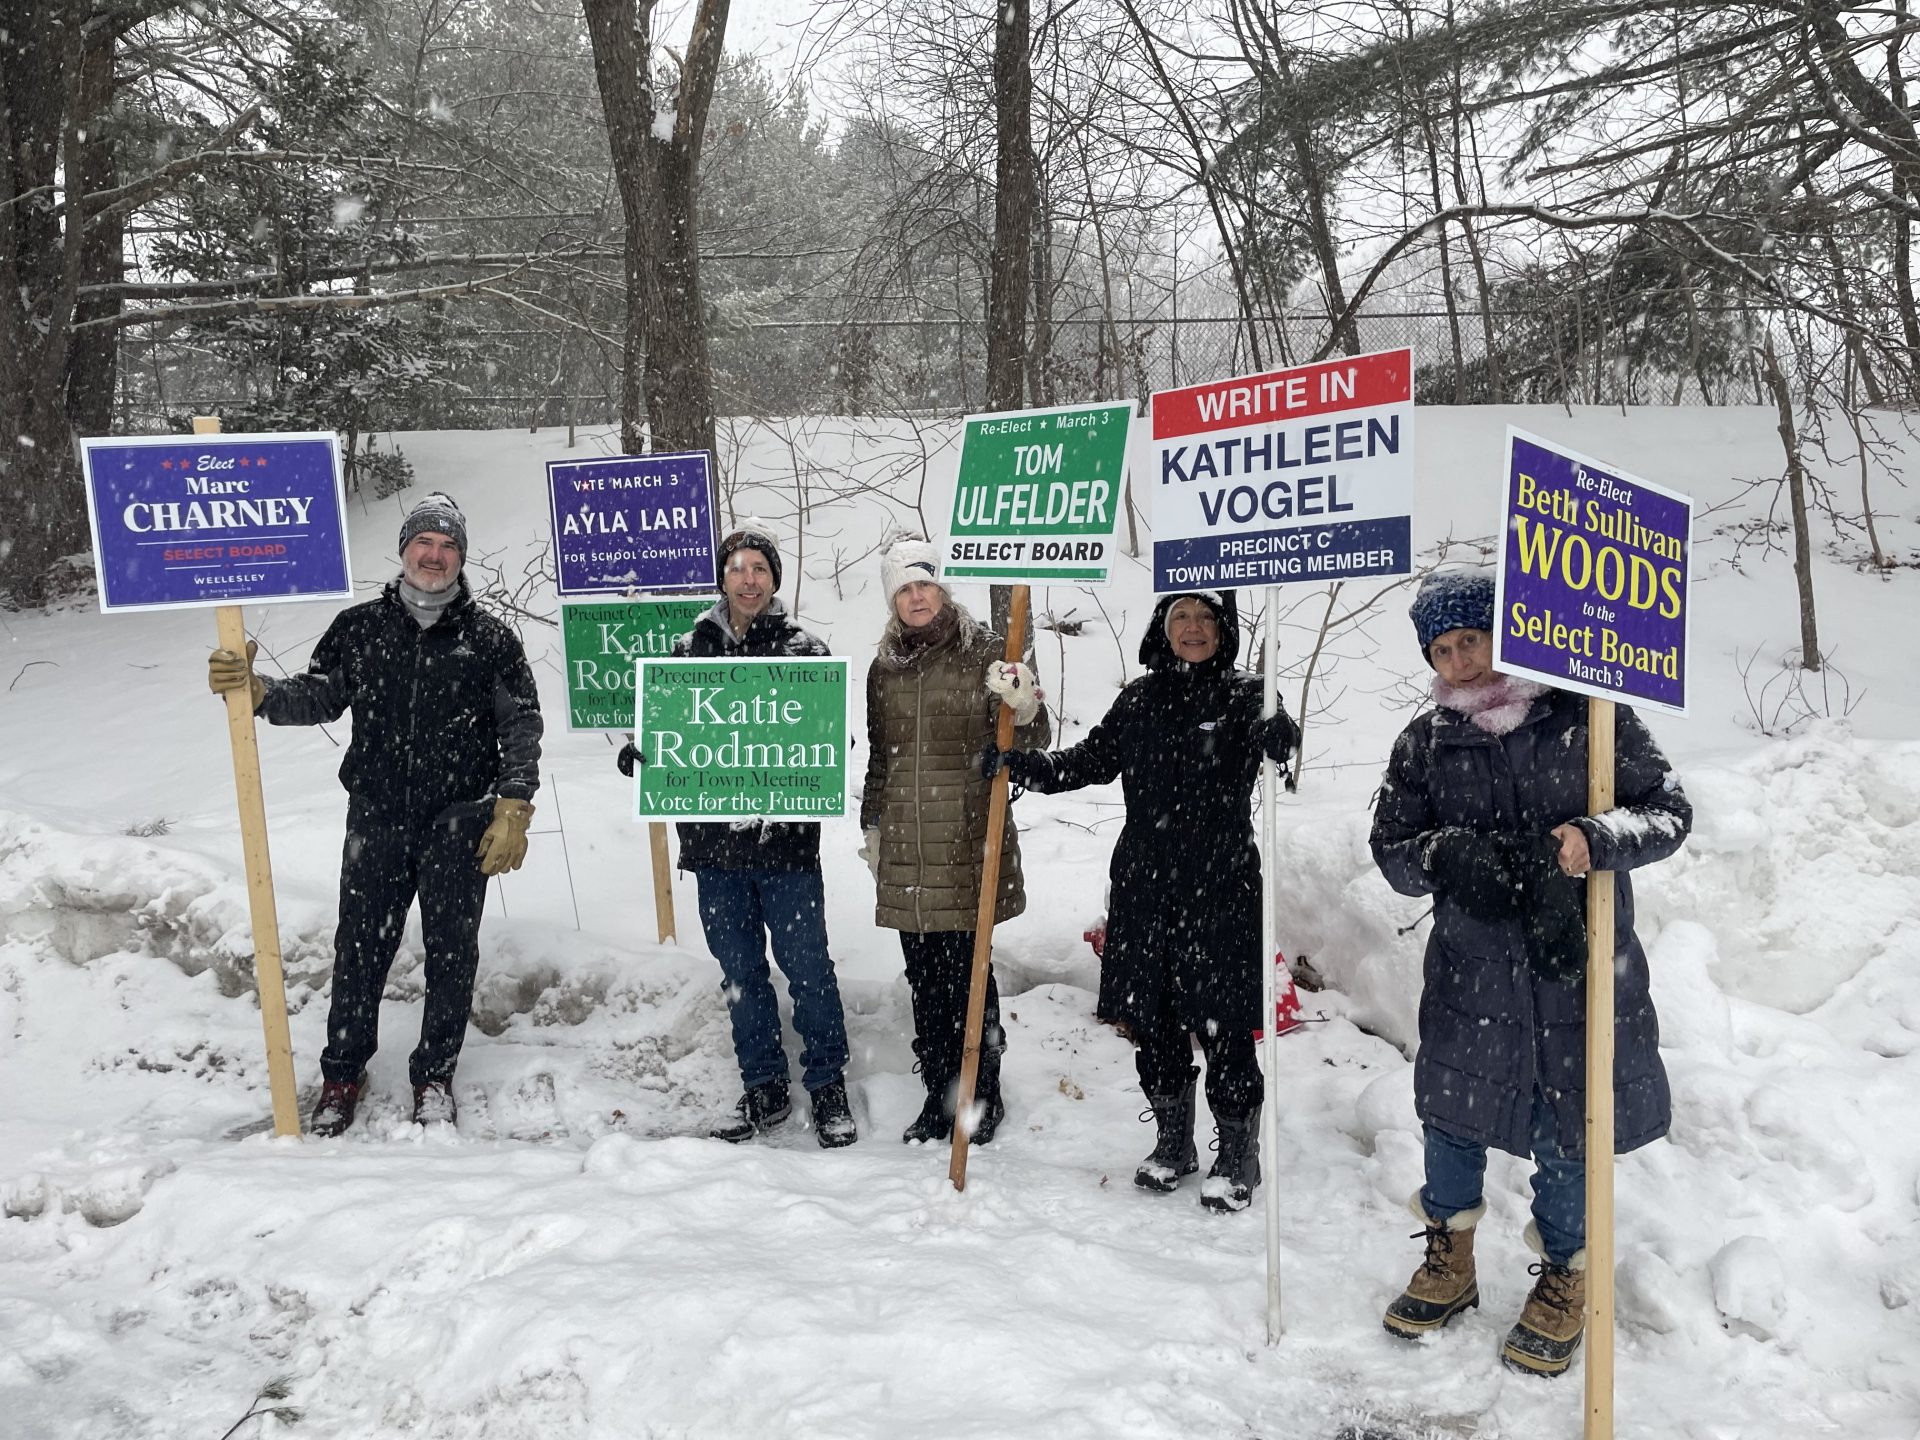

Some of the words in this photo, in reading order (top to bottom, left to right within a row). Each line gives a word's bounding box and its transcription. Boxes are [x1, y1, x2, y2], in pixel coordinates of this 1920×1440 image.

[1196, 377, 1308, 423] WRITE
[1320, 368, 1356, 404] IN
[980, 420, 1032, 435] Re-Elect
[1056, 413, 1096, 429] March
[1101, 412, 1108, 425] 3
[197, 455, 235, 471] Elect
[1014, 443, 1064, 476] TOM
[1162, 414, 1399, 484] KATHLEEN
[185, 476, 250, 495] Marc
[612, 476, 662, 489] MARCH
[670, 474, 678, 486] 3
[1576, 469, 1632, 506] Re-Elect
[123, 496, 314, 532] CHARNEY
[957, 480, 1110, 526] ULFELDER
[1199, 474, 1354, 526] VOGEL
[564, 511, 628, 536] AYLA
[640, 507, 698, 531] LARI
[1518, 472, 1578, 526] Beth
[1584, 500, 1682, 562] Sullivan
[164, 547, 224, 561] SELECT
[229, 544, 286, 558] BOARD
[564, 554, 586, 562] FOR
[592, 551, 636, 562] SCHOOL
[642, 548, 708, 559] COMMITTEE
[950, 542, 1026, 560] SELECT
[1031, 542, 1104, 561] BOARD
[1220, 534, 1312, 557] PRECINCT
[1317, 532, 1330, 548] C
[194, 573, 266, 585] WELLESLEY
[1166, 565, 1215, 584] TOWN
[1220, 558, 1301, 580] MEETING
[1307, 550, 1394, 572] MEMBER
[1514, 514, 1682, 620] WOODS
[568, 607, 624, 621] Precinct
[628, 605, 640, 620] C
[655, 604, 696, 619] Write
[1583, 602, 1594, 617] to
[1596, 604, 1616, 623] the
[596, 624, 684, 655] Katie
[1510, 602, 1594, 657] Select
[1601, 628, 1678, 680] Board
[572, 660, 636, 690] Rod
[650, 666, 726, 684] Precinct
[730, 666, 747, 684] C
[766, 666, 818, 682] Write
[824, 666, 840, 682] in
[1568, 657, 1612, 684] March
[1616, 670, 1624, 688] 3
[588, 692, 605, 706] for
[686, 687, 802, 724] Katie
[572, 708, 610, 724] Vote
[614, 708, 635, 724] for
[650, 730, 838, 768] Rodman
[666, 771, 690, 787] for
[694, 771, 744, 787] Town
[750, 771, 821, 790] Meeting
[644, 792, 692, 811] Vote
[697, 792, 730, 811] for
[732, 792, 765, 811] the
[768, 792, 842, 811] Future!
